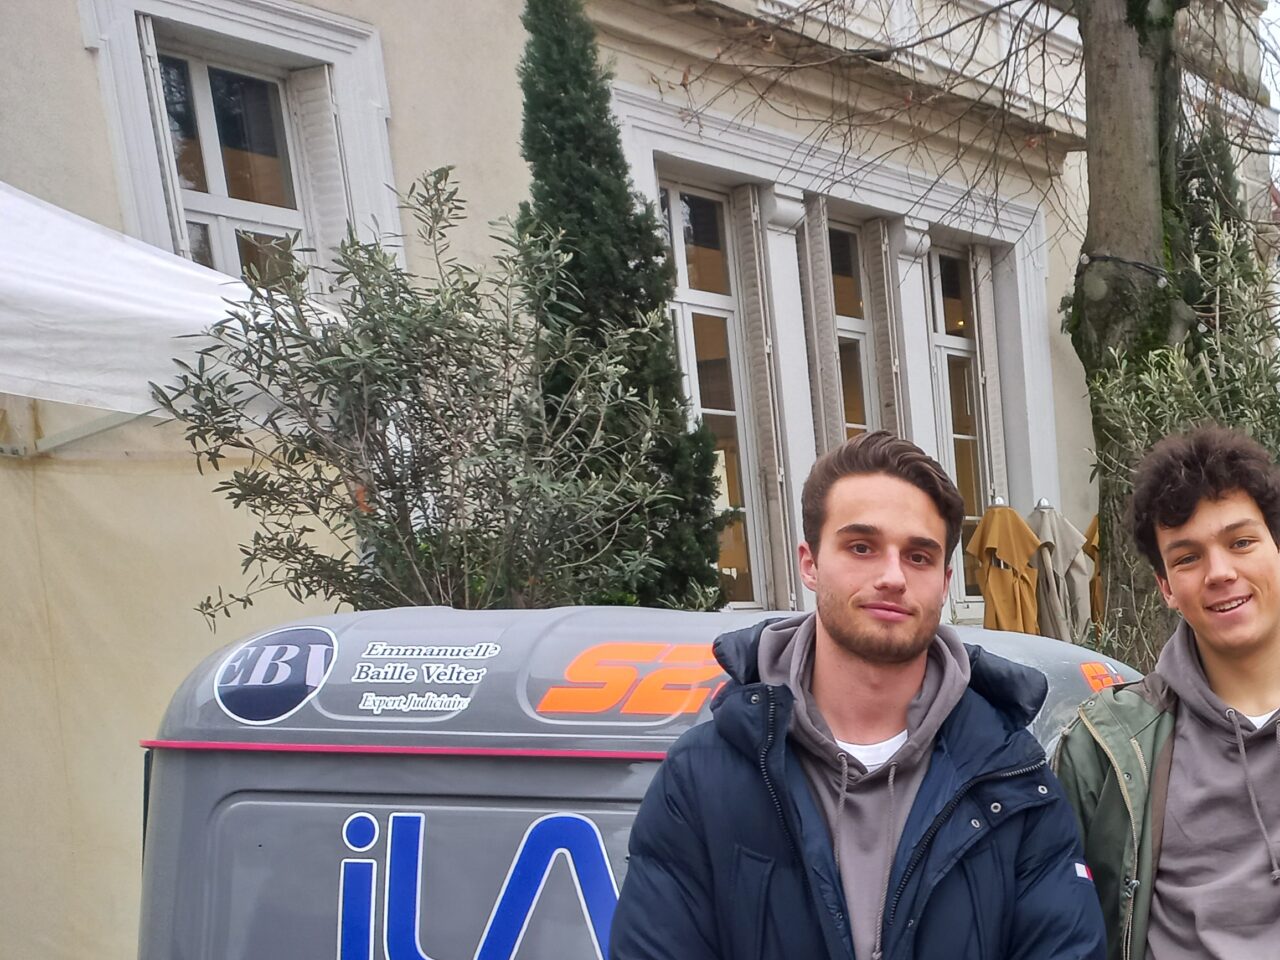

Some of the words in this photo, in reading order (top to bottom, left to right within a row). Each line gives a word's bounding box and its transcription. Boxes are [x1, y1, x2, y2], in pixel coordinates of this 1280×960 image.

[364, 643, 500, 658] Emmanuelle
[354, 664, 416, 683] Baille
[422, 666, 486, 684] Velter
[360, 693, 403, 713] Expert
[404, 694, 471, 711] Judiciaire
